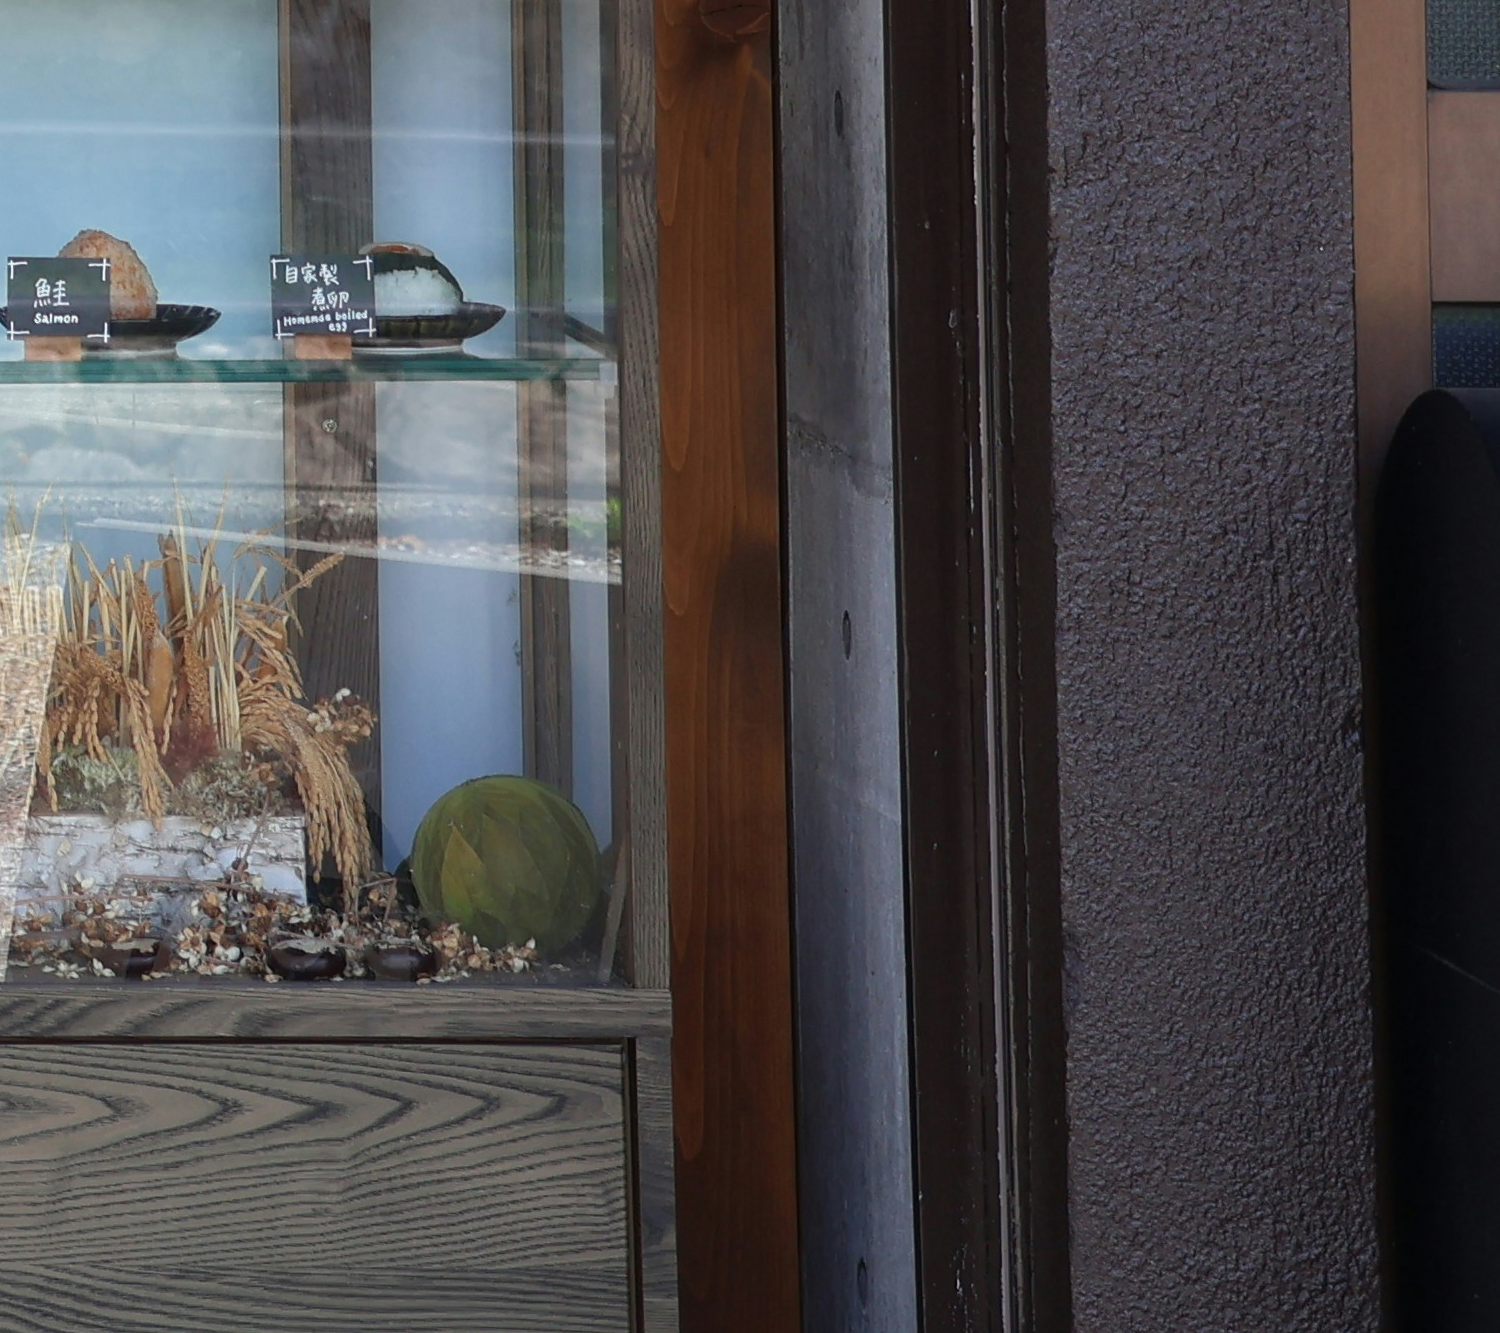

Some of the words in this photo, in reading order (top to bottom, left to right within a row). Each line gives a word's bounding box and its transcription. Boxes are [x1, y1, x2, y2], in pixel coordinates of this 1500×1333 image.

[285, 262, 340, 286] 自家製
[34, 277, 70, 309] 鮭
[311, 286, 350, 311] 煮卵
[33, 312, 79, 325] Salmon
[335, 308, 368, 321] boiled
[328, 321, 348, 332] egg
